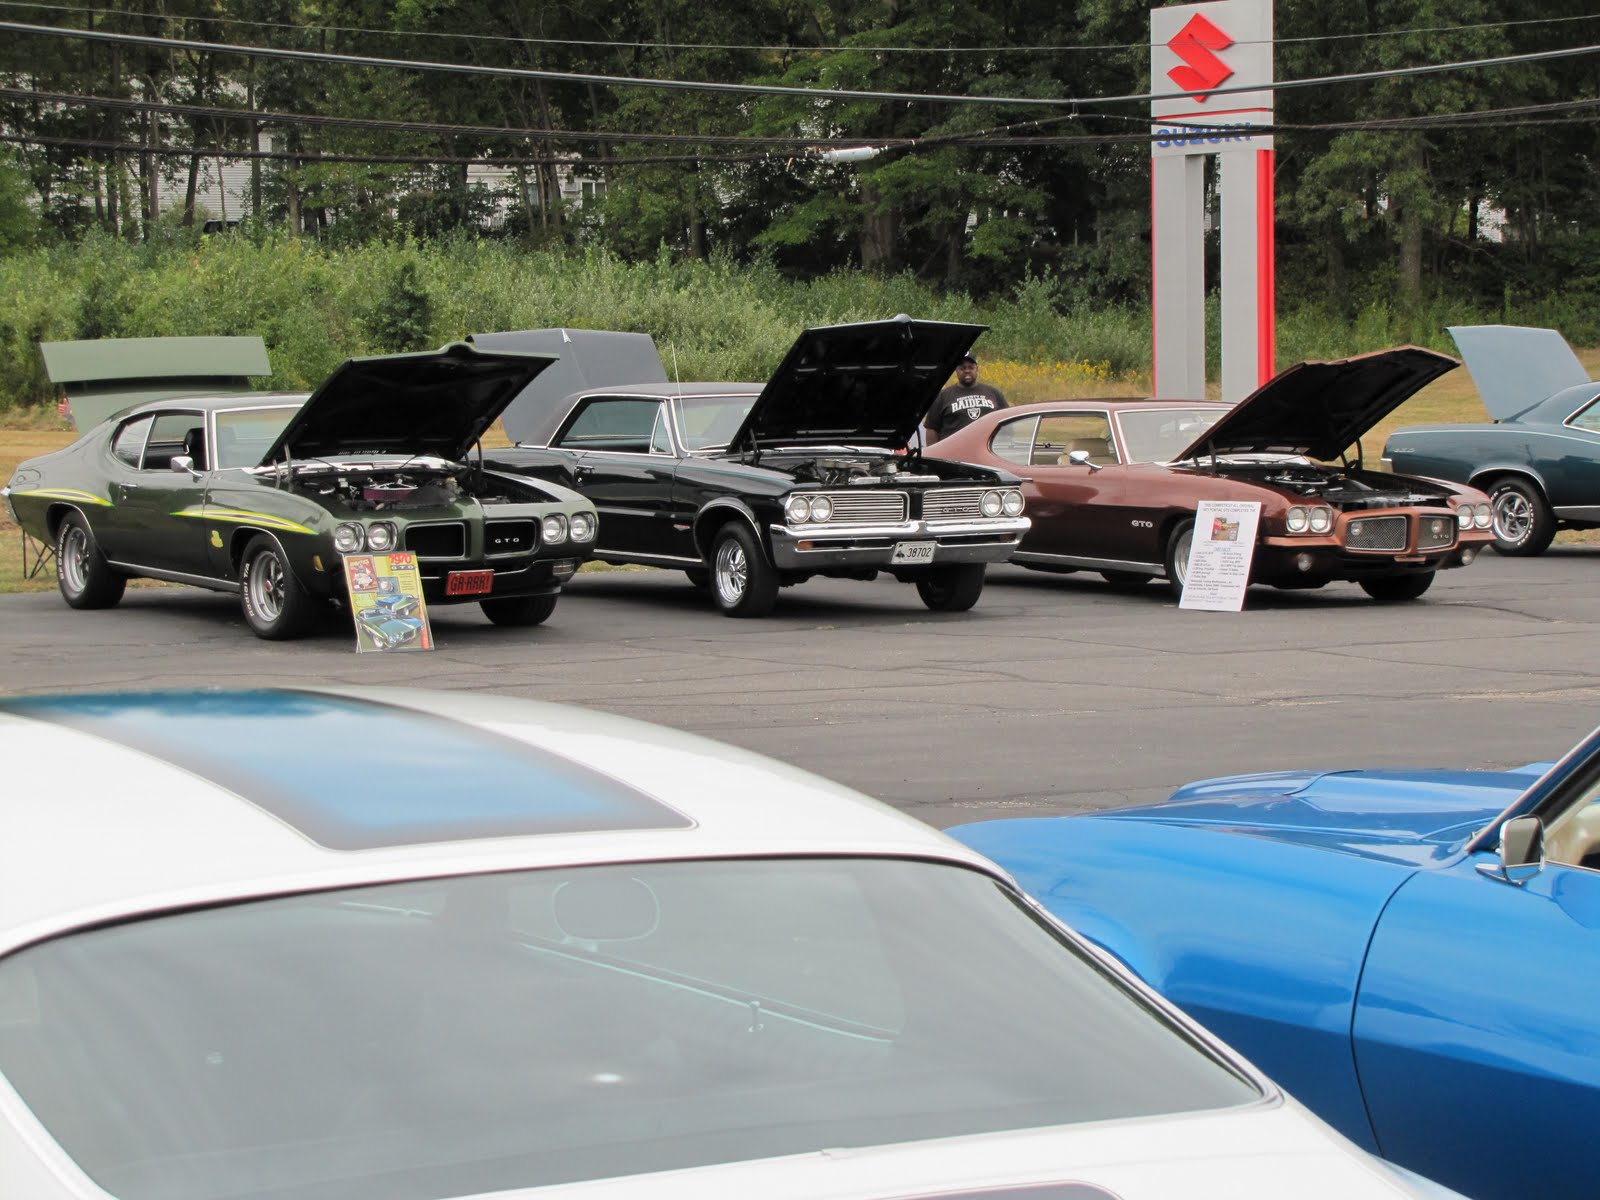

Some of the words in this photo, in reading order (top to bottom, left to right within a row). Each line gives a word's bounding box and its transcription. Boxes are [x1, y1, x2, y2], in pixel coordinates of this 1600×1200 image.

[951, 398, 995, 413] RAIDERS
[1131, 519, 1153, 528] GTO
[907, 547, 932, 558] 38702
